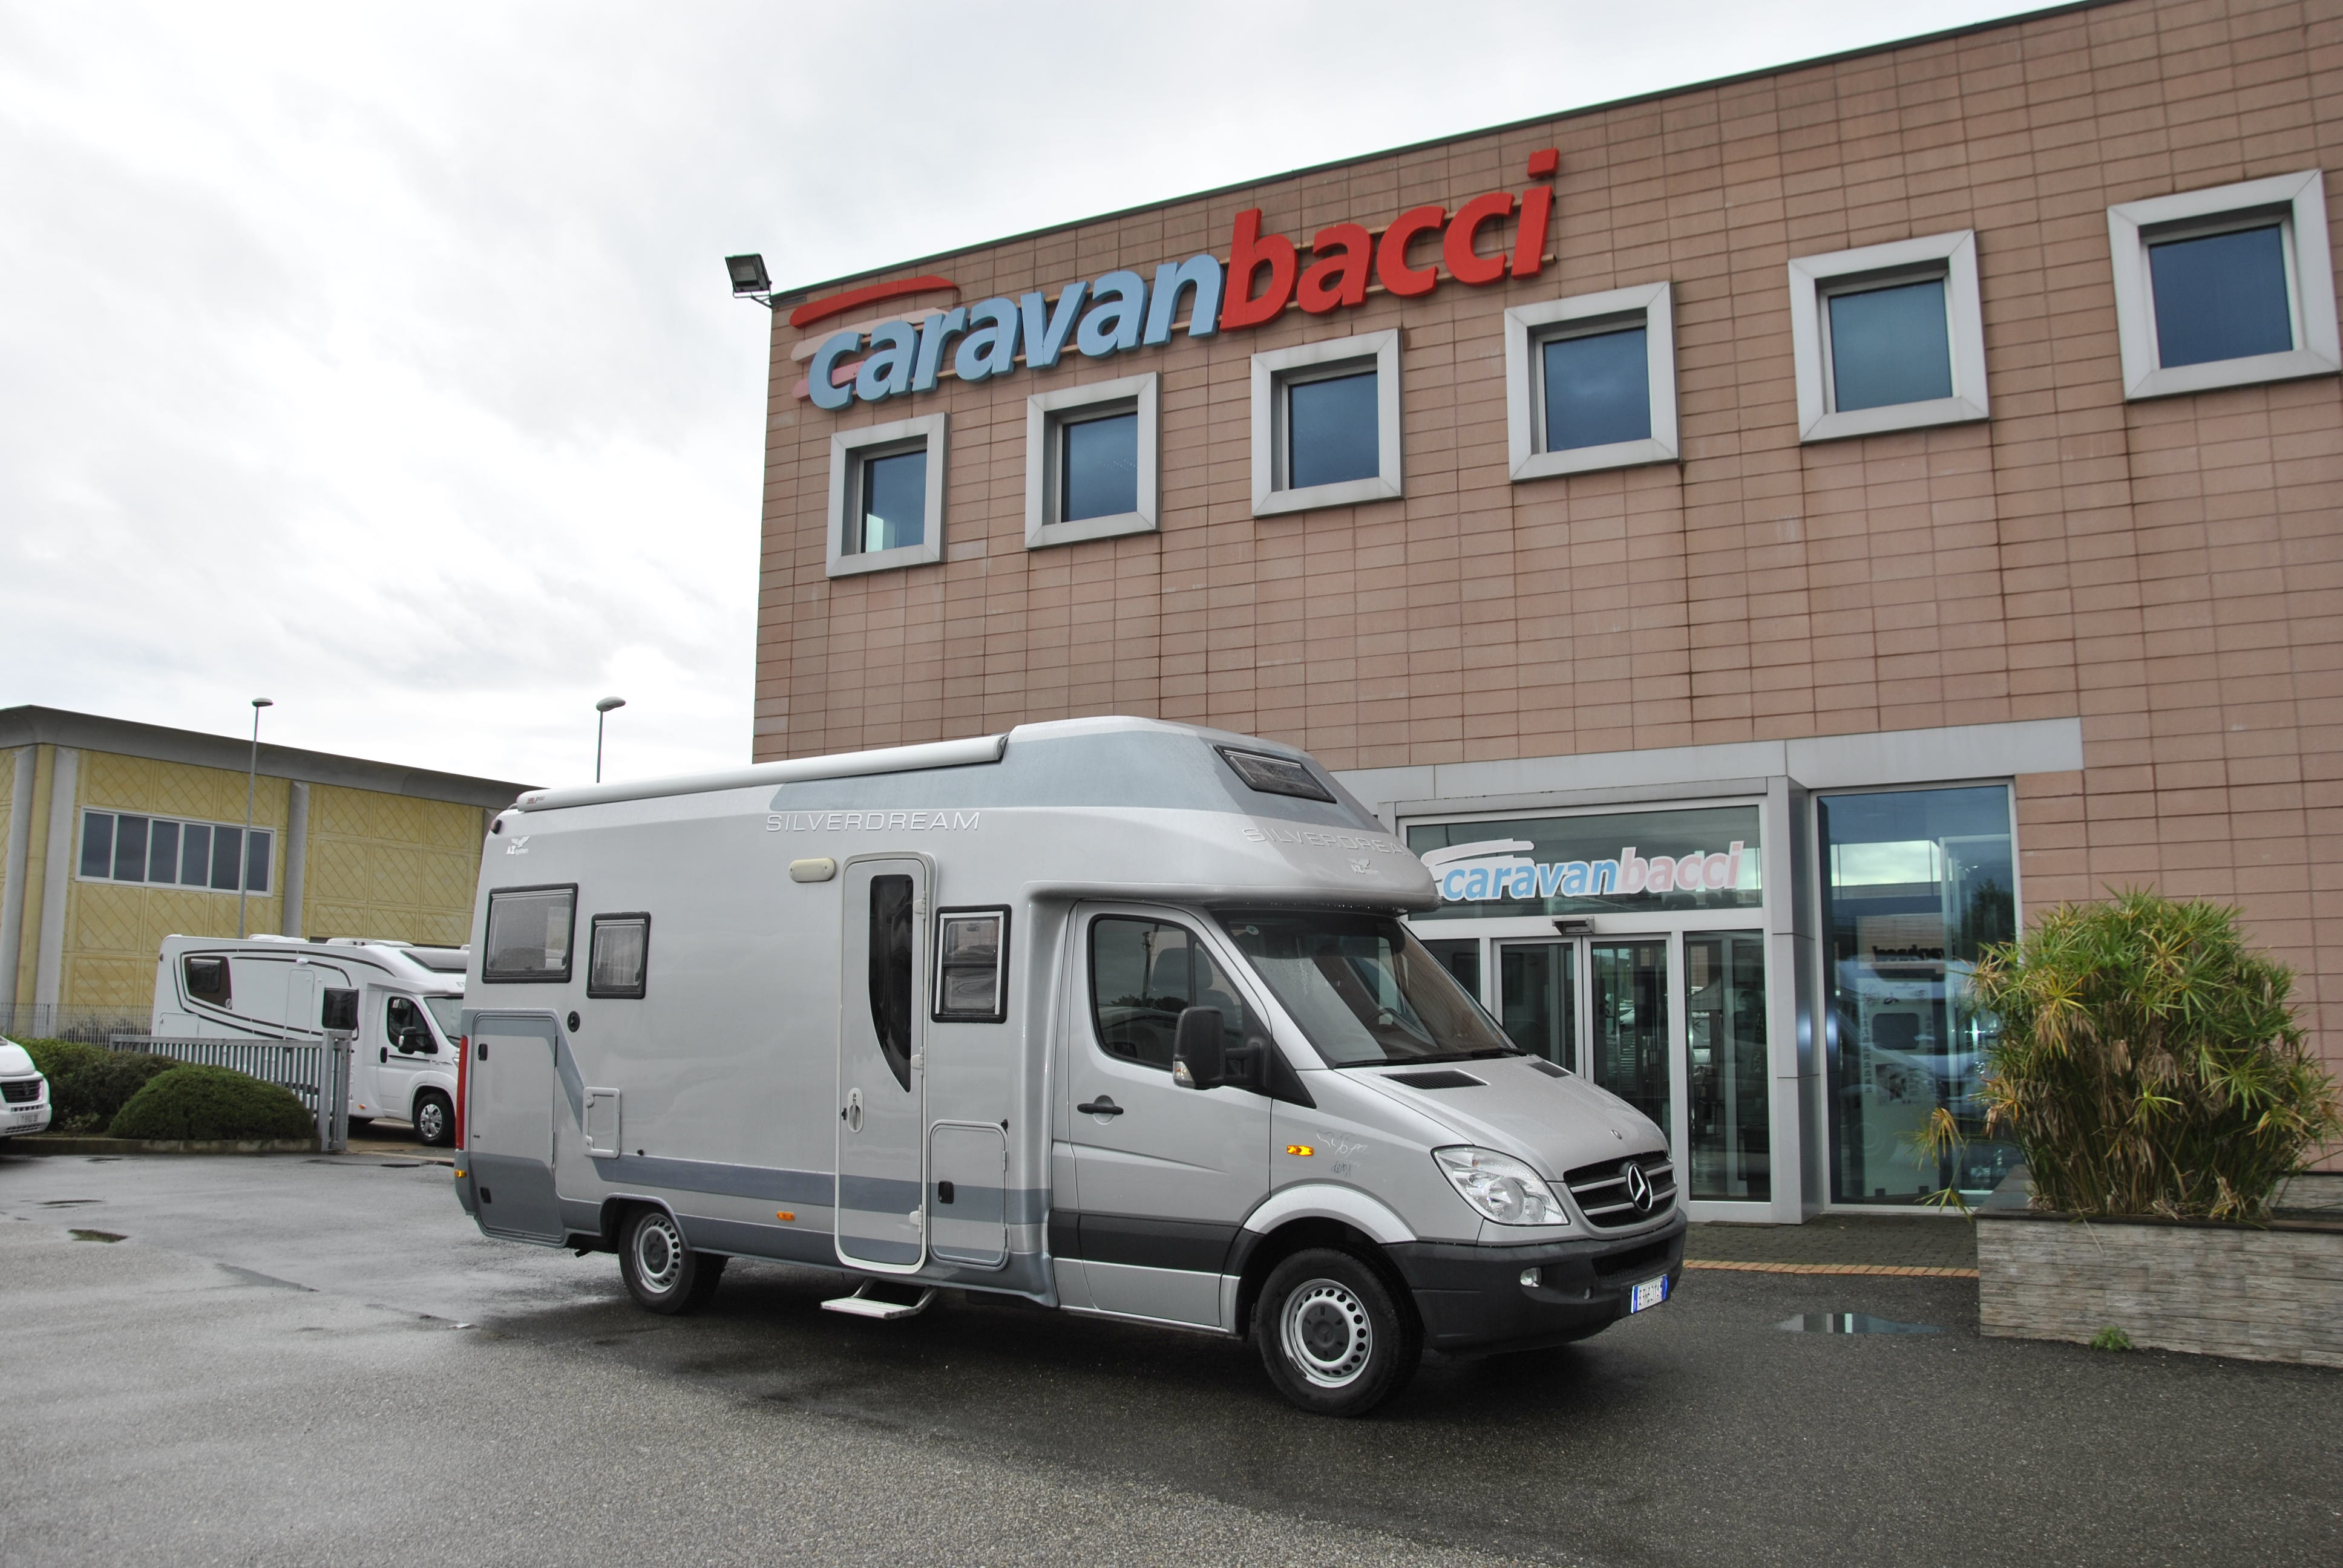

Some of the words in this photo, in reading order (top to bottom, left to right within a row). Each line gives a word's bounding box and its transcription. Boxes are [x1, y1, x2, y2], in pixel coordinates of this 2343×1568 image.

[807, 147, 1560, 411] caravanbacci
[765, 811, 981, 832] SILVERDREAM
[1441, 840, 1745, 901] caravanbacci
